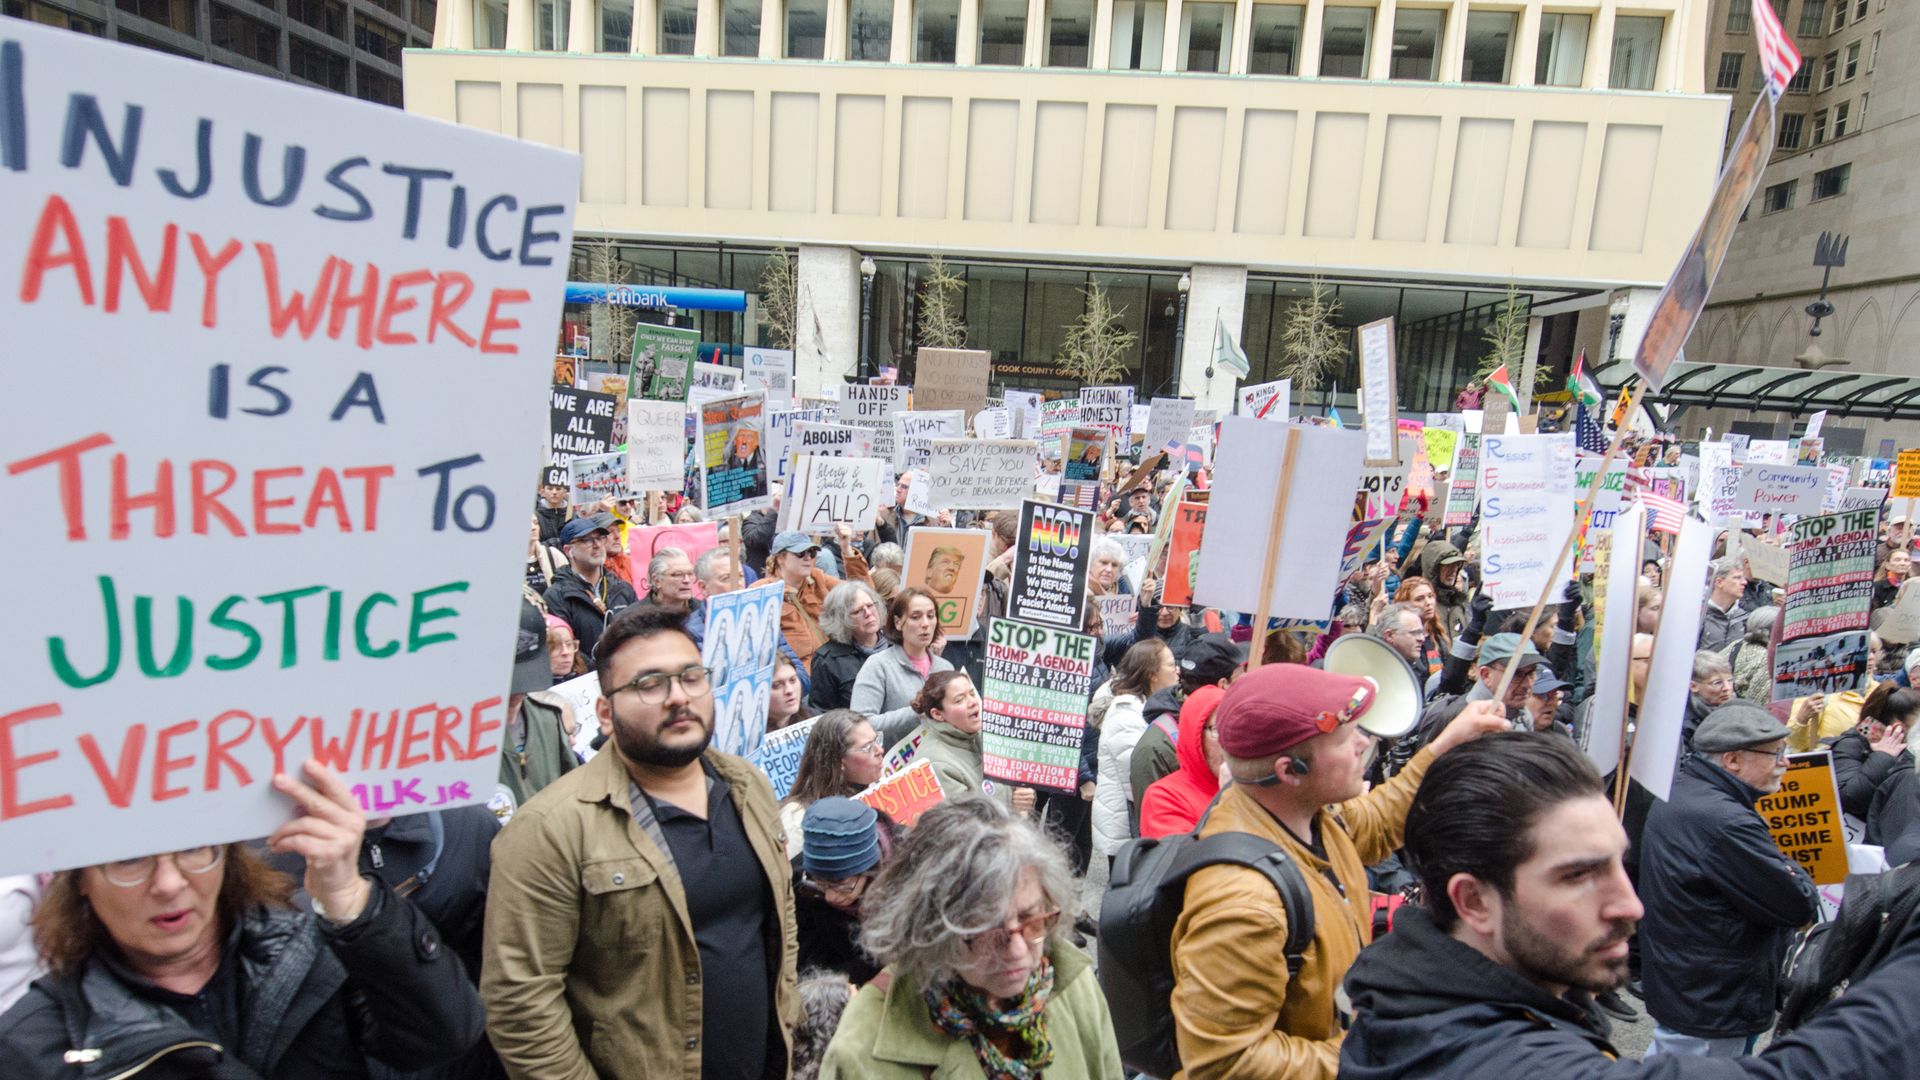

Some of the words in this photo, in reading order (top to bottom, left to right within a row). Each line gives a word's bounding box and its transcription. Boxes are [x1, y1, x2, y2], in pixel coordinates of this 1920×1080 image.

[0, 40, 565, 266] INJUSTICE
[19, 194, 531, 354] ANYWHERE
[607, 287, 668, 307] citibank
[997, 364, 1020, 373] COOK
[1022, 365, 1055, 375] COUNTY
[208, 363, 292, 420] IS
[329, 371, 386, 425] A
[849, 387, 899, 400] HANDS
[1081, 389, 1121, 405] TEACHING
[554, 393, 577, 411] WE
[585, 399, 615, 417] ARE
[858, 403, 888, 416] OFF
[1080, 407, 1123, 423] HONEST
[567, 417, 595, 434] ALL
[903, 419, 946, 435] WHAT
[553, 433, 605, 454] KILMAR
[803, 430, 852, 446] ABOLISH
[974, 444, 984, 456] IS
[985, 444, 1023, 456] COMING
[1025, 446, 1037, 456] TO
[949, 455, 991, 473] SAVE
[1000, 460, 1024, 474] YOU
[6, 432, 394, 541] THREAT
[1758, 470, 1818, 488] Community
[1754, 488, 1800, 503] Power
[812, 494, 869, 523] ALL?
[1029, 505, 1083, 559] NO!
[1794, 517, 1836, 541] STOP
[1842, 511, 1876, 532] THE
[1826, 530, 1874, 546] AGENDA!
[1838, 541, 1877, 552] EXPAND
[1029, 553, 1037, 564] In
[1038, 555, 1051, 566] the
[1052, 557, 1074, 570] Name
[1841, 549, 1875, 559] RIGHTS
[1027, 565, 1037, 574] of
[1037, 567, 1074, 583] Humanity
[1840, 572, 1873, 582] CRIMES
[1026, 576, 1040, 587] We
[1040, 578, 1073, 594] REFUSE
[1840, 589, 1871, 598] RIGHTS
[1027, 587, 1035, 596] to
[1036, 589, 1062, 602] Accept
[1063, 595, 1069, 603] a
[1016, 595, 1044, 609] Fascist
[1047, 601, 1076, 615] America
[1100, 598, 1133, 615] ESPECT
[47, 576, 469, 688] JUSTICE
[991, 621, 1047, 651] STOP
[1054, 633, 1092, 660] THE
[988, 644, 1029, 663] TRUMP
[1033, 654, 1090, 675] AGENDA!
[985, 669, 1045, 687] IMMIGRANT
[1050, 682, 1090, 695] RIGHTS
[986, 659, 1027, 675] DEFEND
[1033, 668, 1040, 678] &
[1046, 671, 1091, 686] EXPAND
[1015, 685, 1036, 696] WITH
[1040, 690, 1088, 705] PALESTINE
[983, 698, 1004, 709] STOP
[1008, 705, 1045, 719] POLICE
[1048, 712, 1085, 726] CRIMES
[983, 711, 1011, 726] DEFEND
[1015, 719, 1060, 734] LGBTQIA+
[1062, 727, 1084, 738] AND
[983, 721, 1045, 742] REPRODUCTIVE
[1047, 734, 1081, 748] RIGHTS
[0, 695, 501, 821] EVERYWHERE
[984, 754, 1008, 767] DEFEND
[1011, 761, 1065, 777] EDUCATION
[984, 764, 1022, 780] ACADEMIC
[1027, 772, 1077, 787] FREEDOM
[430, 780, 472, 806] JR
[864, 763, 941, 816] USTICE
[1778, 780, 1799, 793] he
[1755, 793, 1820, 812] RUMP
[1769, 811, 1830, 830] SCIST
[1772, 830, 1832, 847] EGIME
